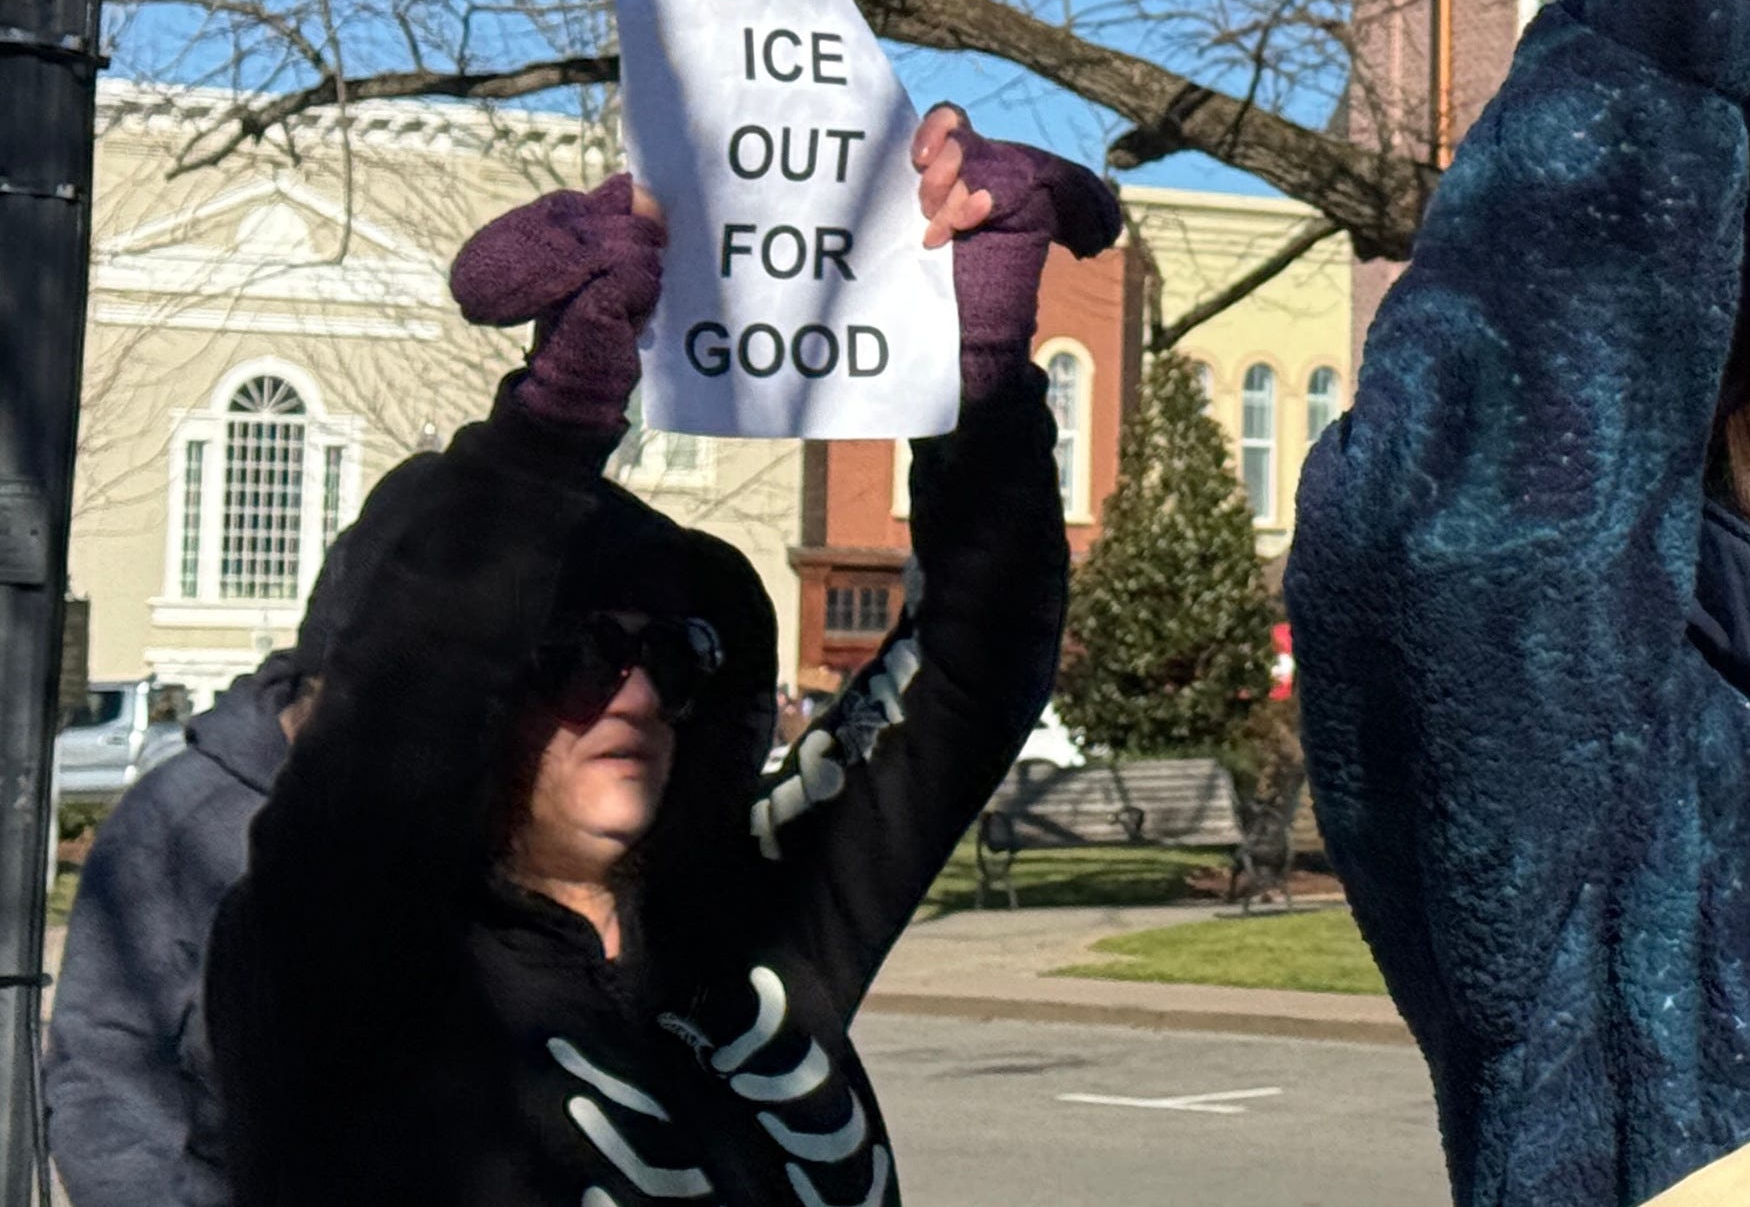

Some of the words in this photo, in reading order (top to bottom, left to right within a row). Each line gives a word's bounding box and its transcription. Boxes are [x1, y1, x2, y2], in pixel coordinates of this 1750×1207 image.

[743, 27, 848, 85] ICE
[728, 124, 866, 183] OUT
[719, 223, 857, 282] FOR
[684, 321, 890, 379] GOOD
